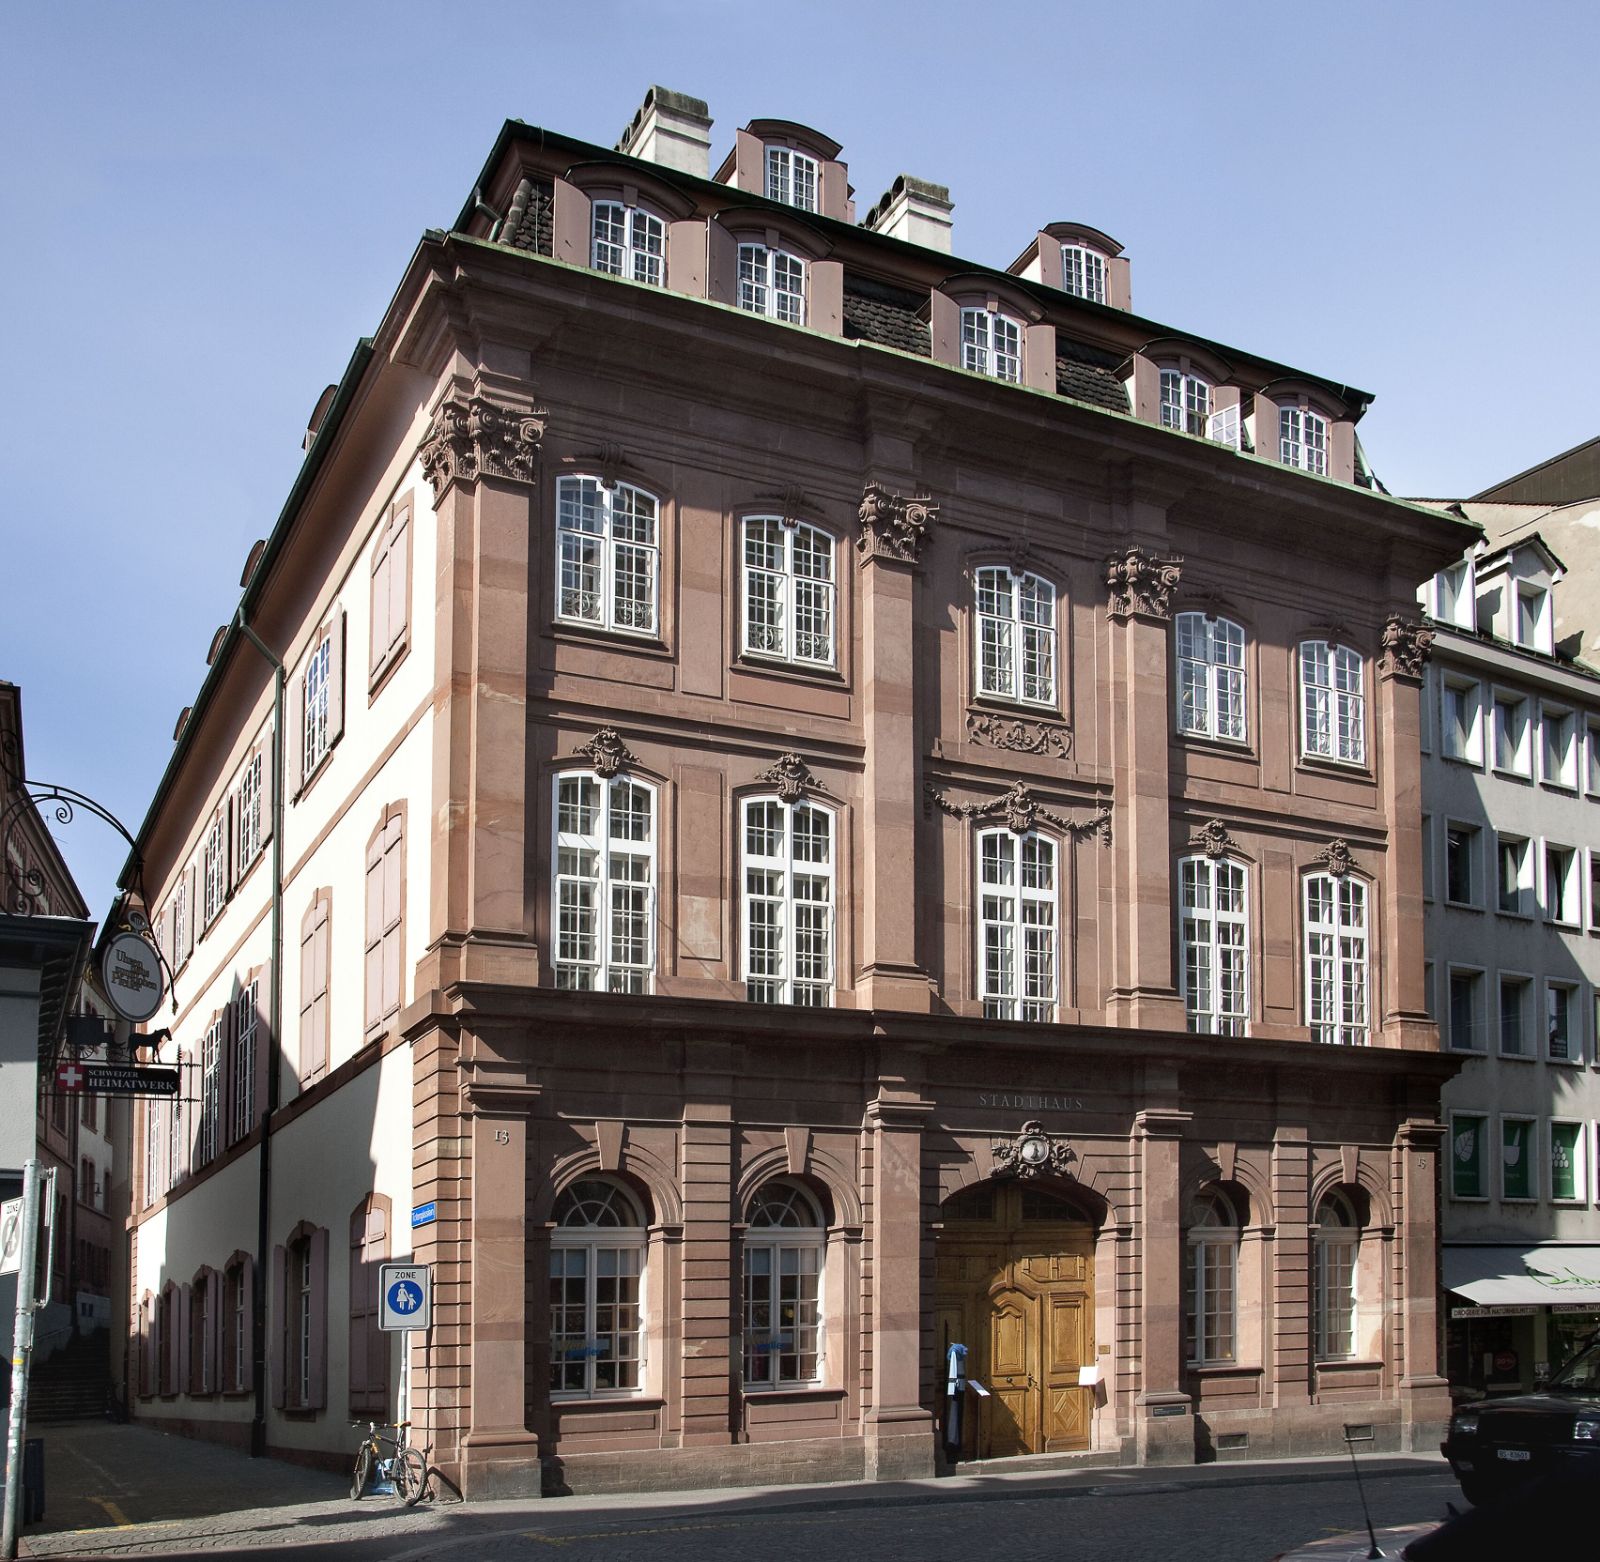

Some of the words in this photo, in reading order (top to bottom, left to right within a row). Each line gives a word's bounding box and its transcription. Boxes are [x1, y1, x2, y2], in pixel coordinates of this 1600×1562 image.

[88, 1069, 139, 1078] SCHWEIZER
[88, 1078, 175, 1090] HEIMATWERK
[979, 1093, 1083, 1109] STADTHAUS
[495, 1129, 510, 1146] 13
[1453, 1308, 1480, 1317] DROGERIE
